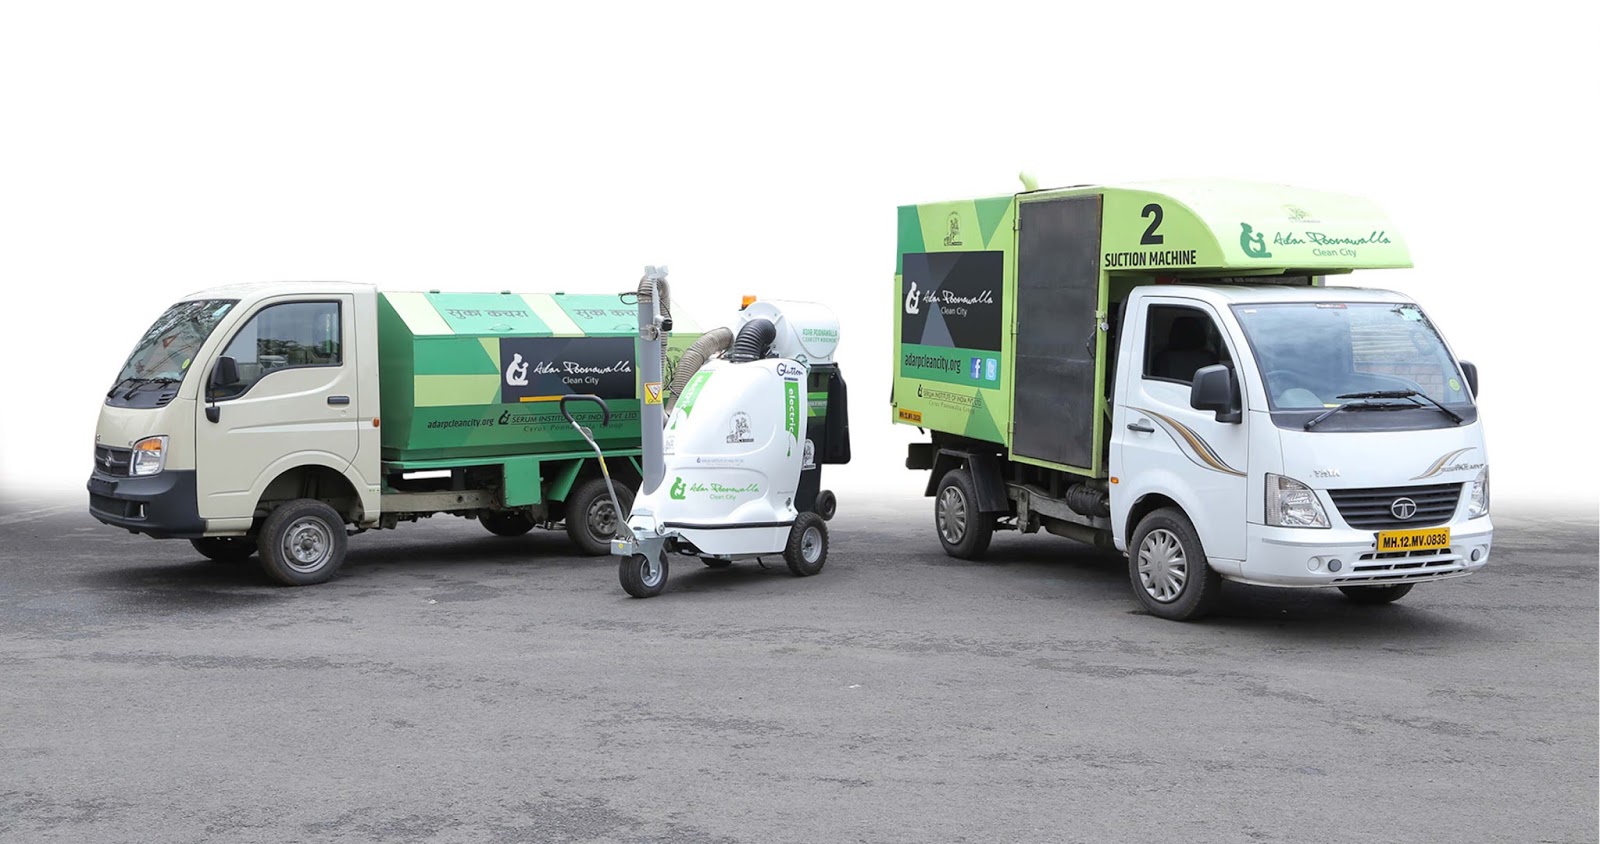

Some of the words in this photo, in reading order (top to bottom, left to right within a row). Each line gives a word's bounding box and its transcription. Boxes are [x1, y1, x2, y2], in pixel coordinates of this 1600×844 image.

[1140, 203, 1164, 245] 2
[1273, 231, 1306, 246] Adar
[1306, 230, 1391, 245] Poonawalla
[1105, 251, 1146, 267] SUCTION
[1149, 250, 1196, 265] MACHINE
[1312, 248, 1338, 257] Clean
[1339, 248, 1357, 258] City
[608, 309, 638, 317] कच
[941, 307, 956, 315] Clean
[956, 307, 967, 317] City
[563, 360, 631, 374] Poonawalla
[905, 353, 961, 374] adarpcleancity.org
[562, 376, 583, 384] Clean
[584, 376, 599, 385] City
[788, 388, 796, 433] electric
[427, 418, 494, 429] adarpcleancity.org
[1383, 533, 1447, 548] MH.12.MV.0838
